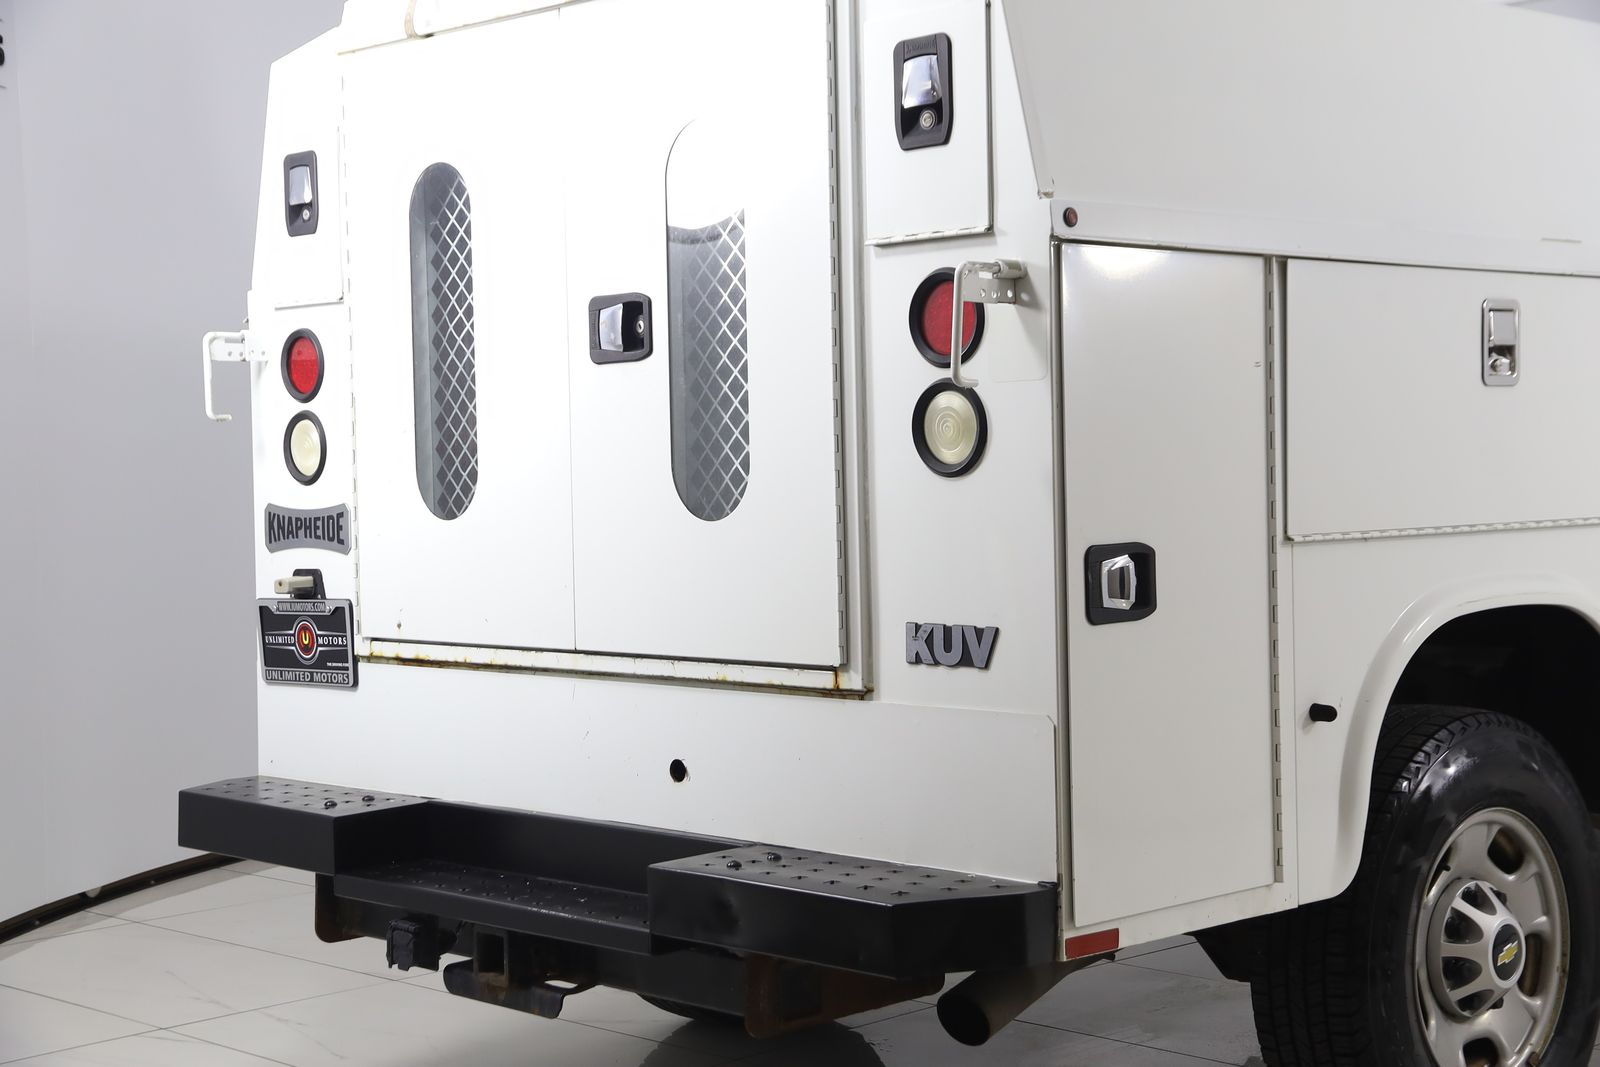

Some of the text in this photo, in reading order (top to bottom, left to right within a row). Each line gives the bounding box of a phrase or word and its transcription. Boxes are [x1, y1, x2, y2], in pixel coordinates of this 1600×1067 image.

[268, 511, 345, 545] KNAPHEIDE
[265, 630, 347, 645] UNLIMITED U MOTORS
[905, 621, 999, 669] KUV
[266, 670, 349, 684] UNLIMITED MOTORS
